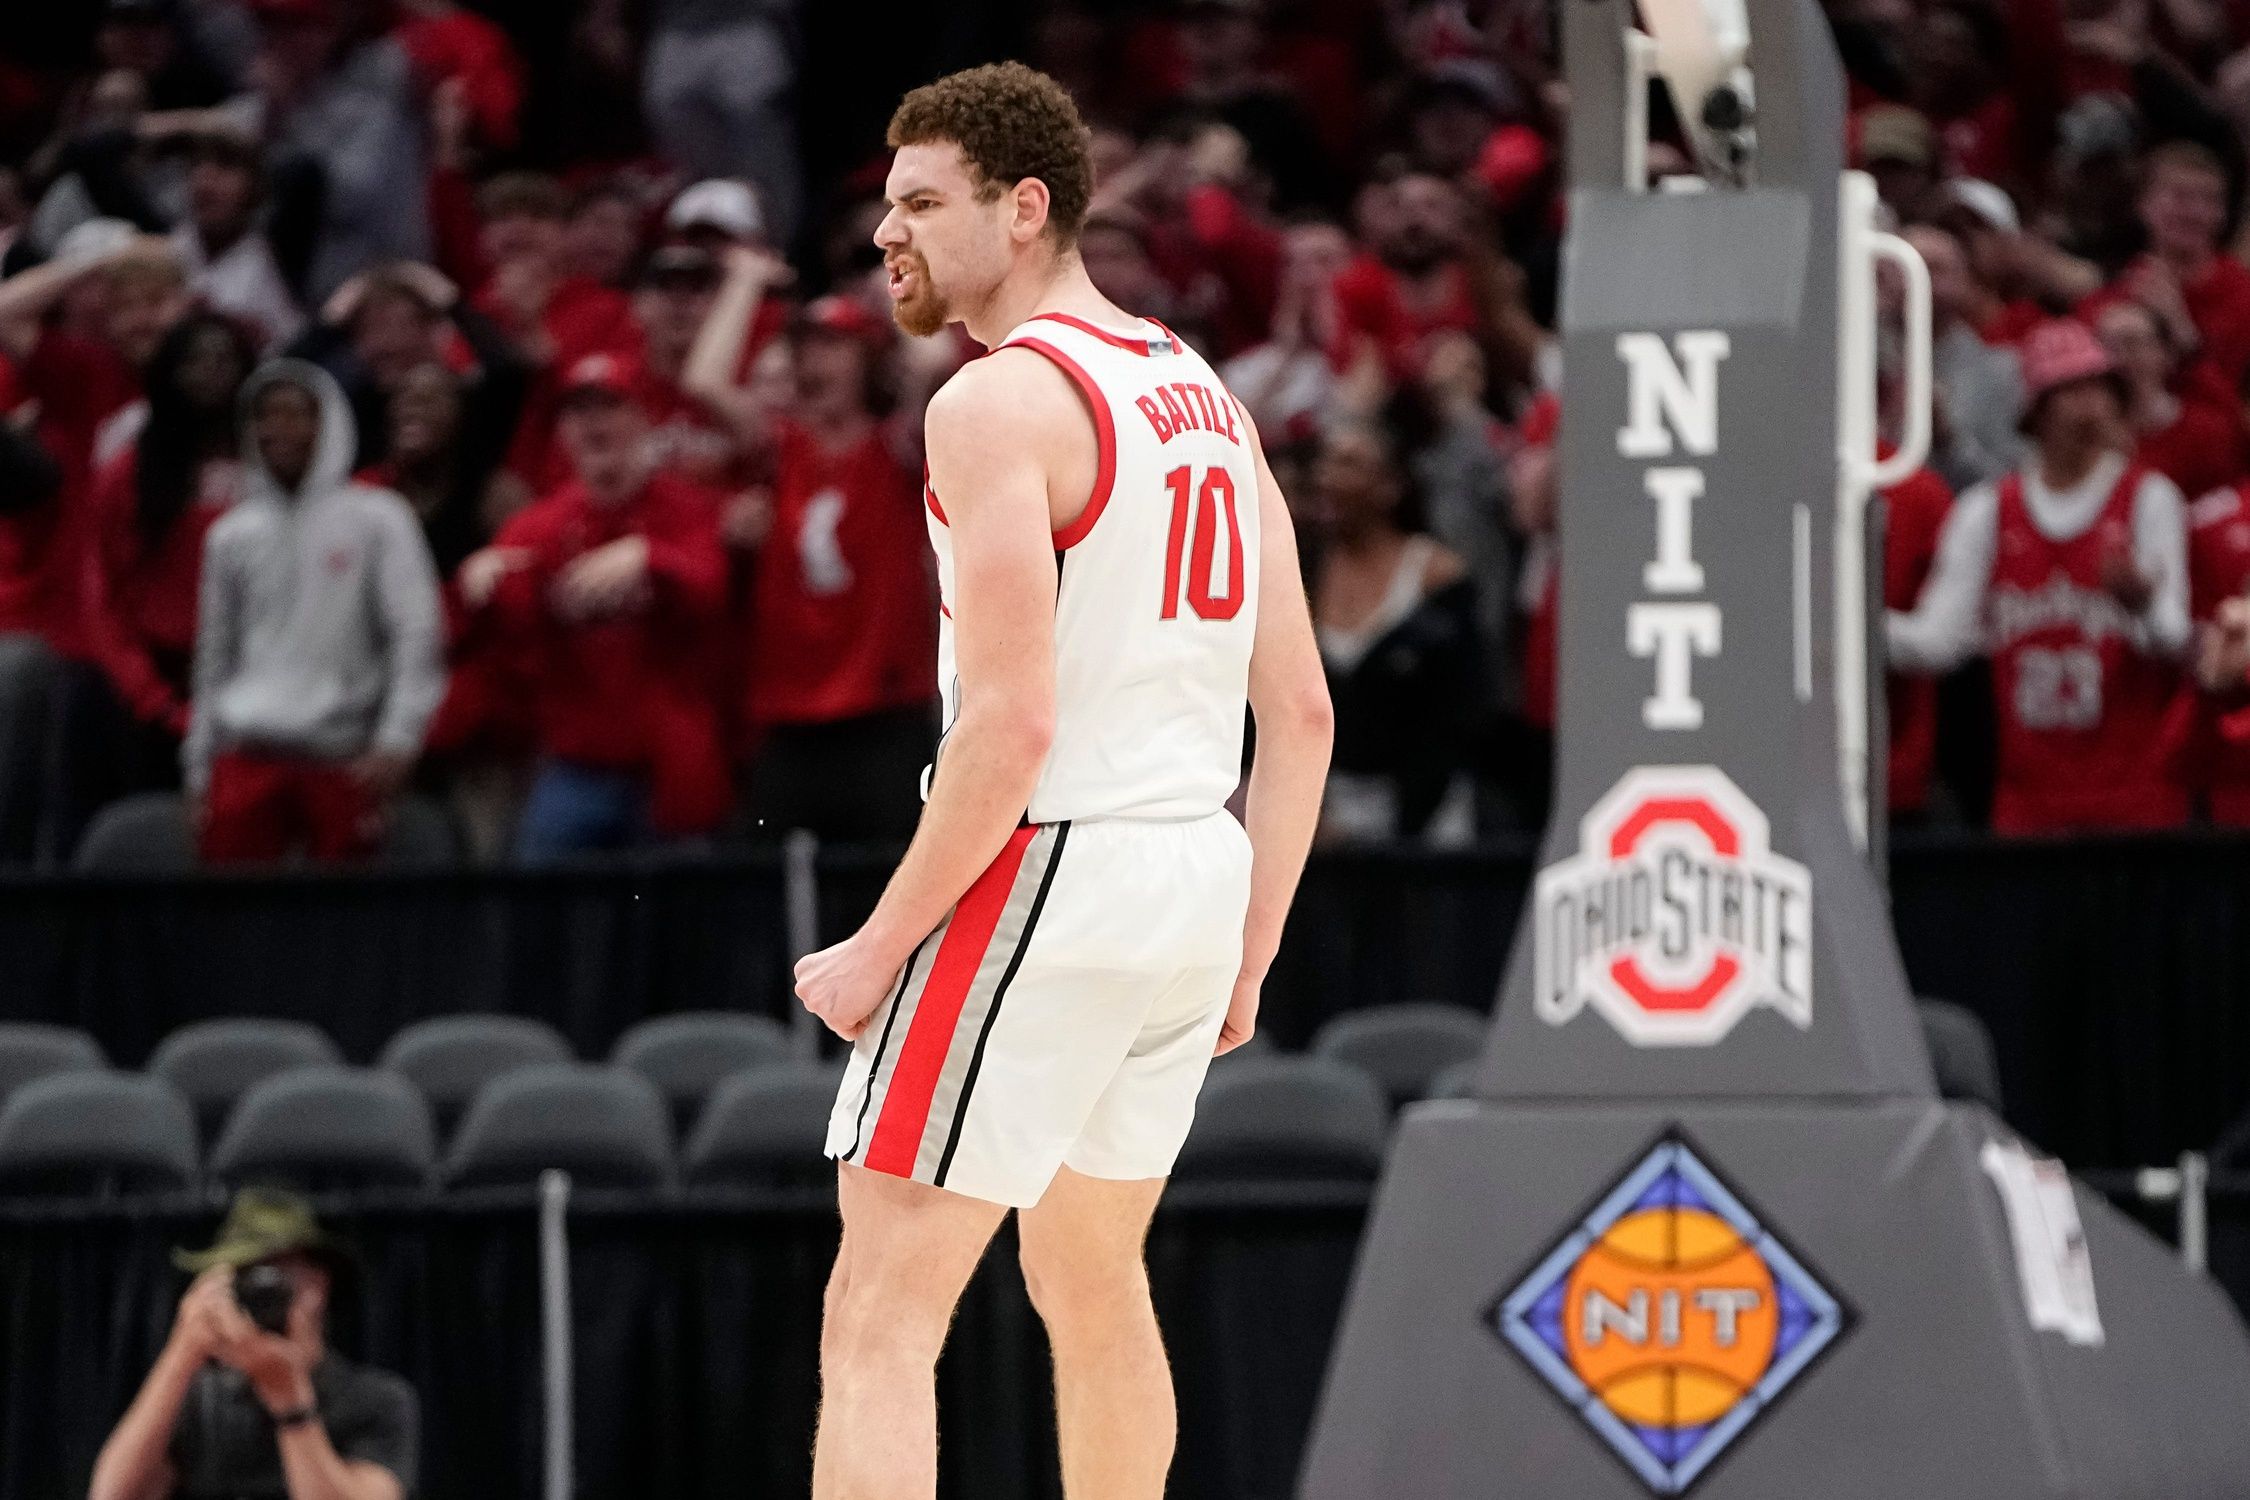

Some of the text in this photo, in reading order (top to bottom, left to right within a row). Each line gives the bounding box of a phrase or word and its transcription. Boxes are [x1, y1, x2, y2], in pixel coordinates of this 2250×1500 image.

[1135, 383, 1240, 445] BATTLE
[1159, 463, 1245, 621] 10
[1616, 330, 1731, 731] NIT
[1659, 849, 1804, 1006] STATE
[1582, 1287, 1761, 1347] NIT
